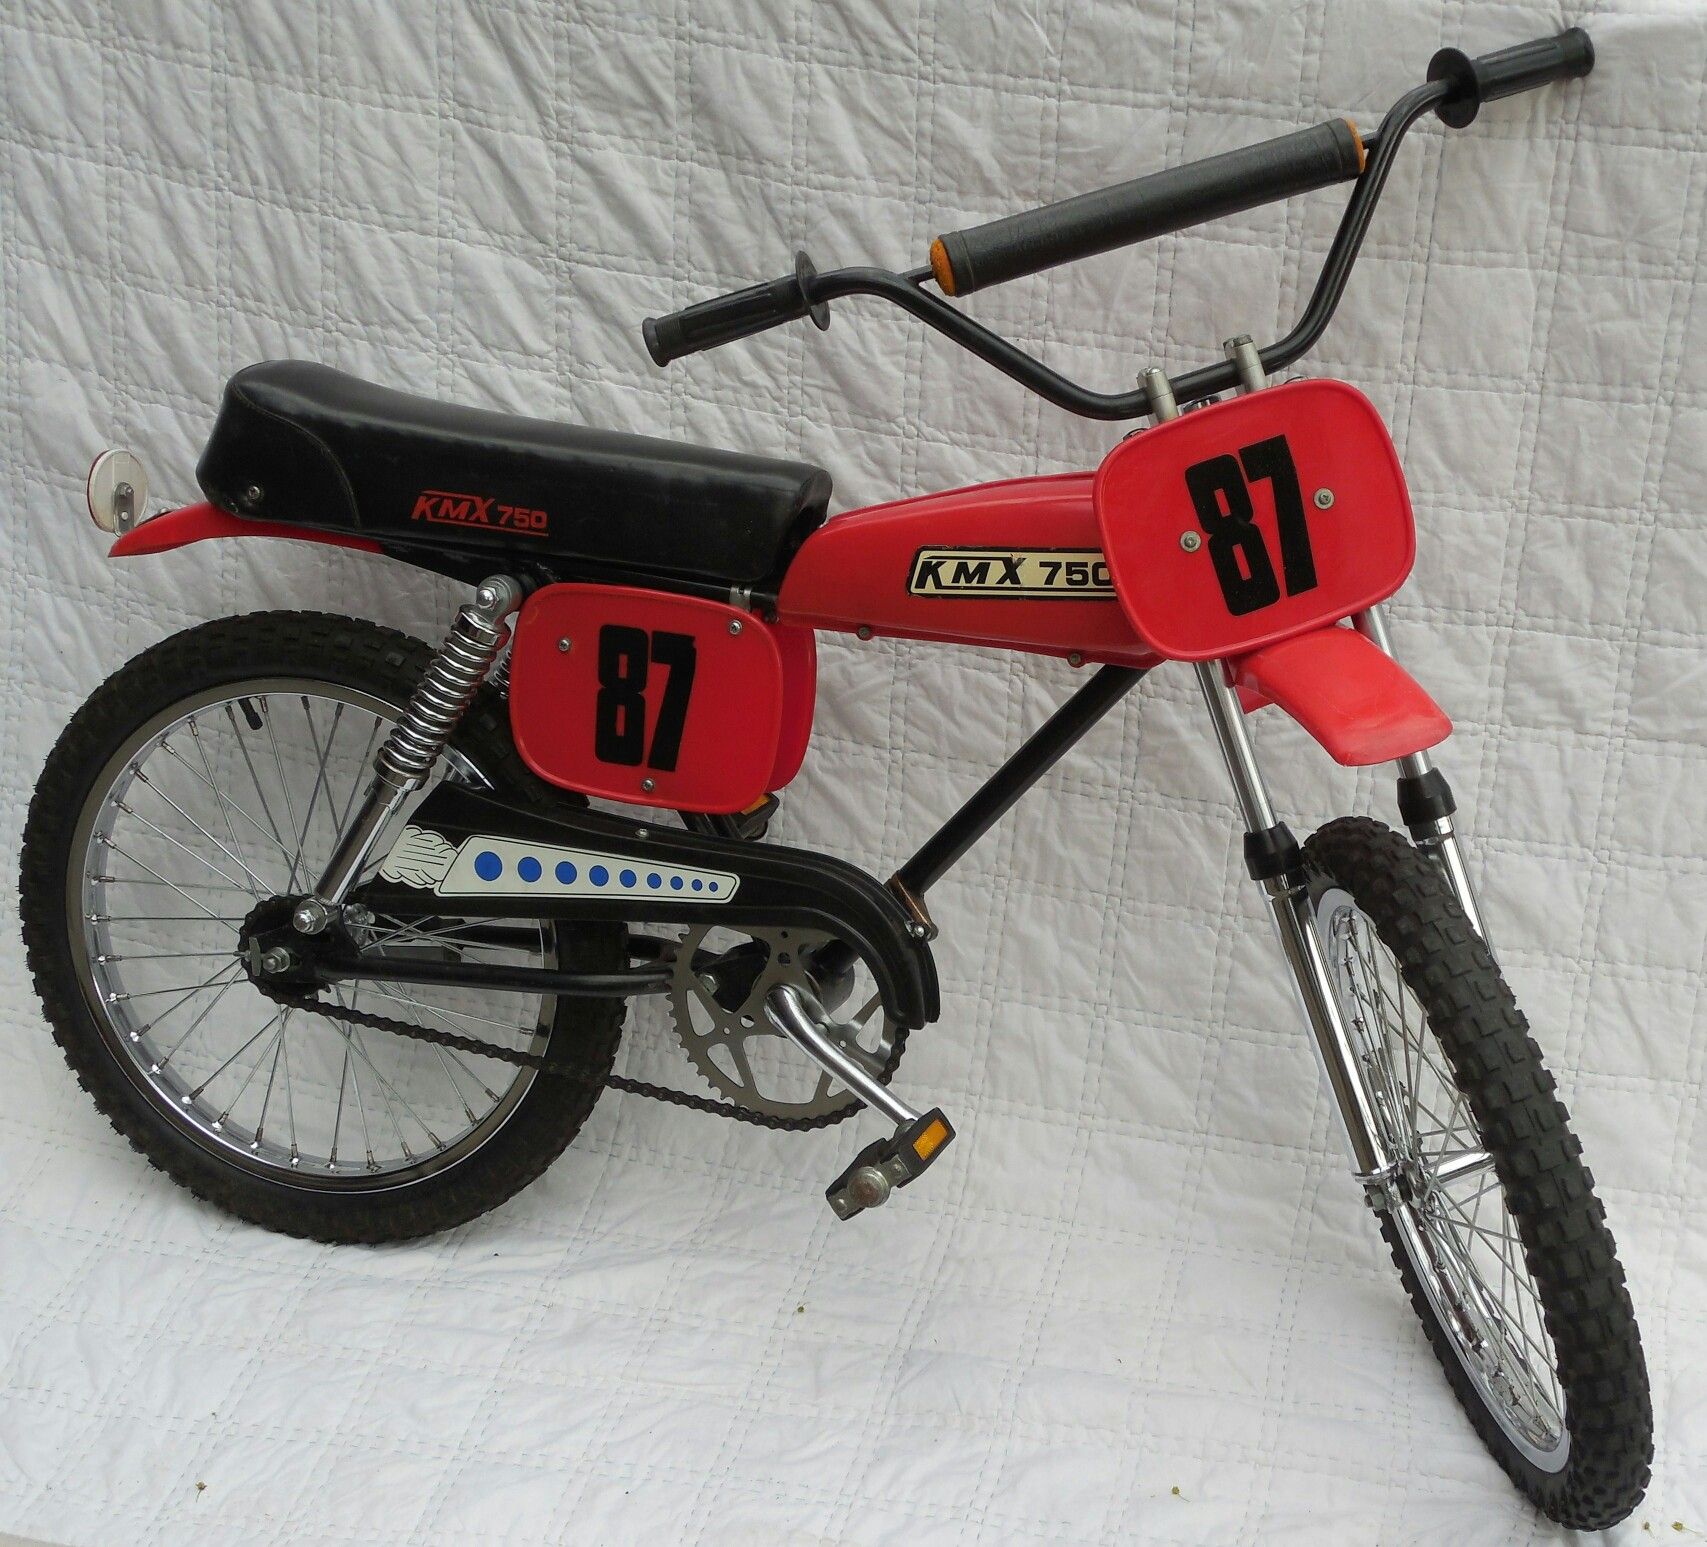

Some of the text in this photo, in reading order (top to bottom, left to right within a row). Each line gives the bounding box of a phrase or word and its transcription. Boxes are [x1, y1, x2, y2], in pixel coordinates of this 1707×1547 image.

[411, 490, 548, 530] KMX 750
[1185, 434, 1318, 617] 87
[914, 556, 1113, 590] KMX 750
[595, 624, 697, 773] 87
